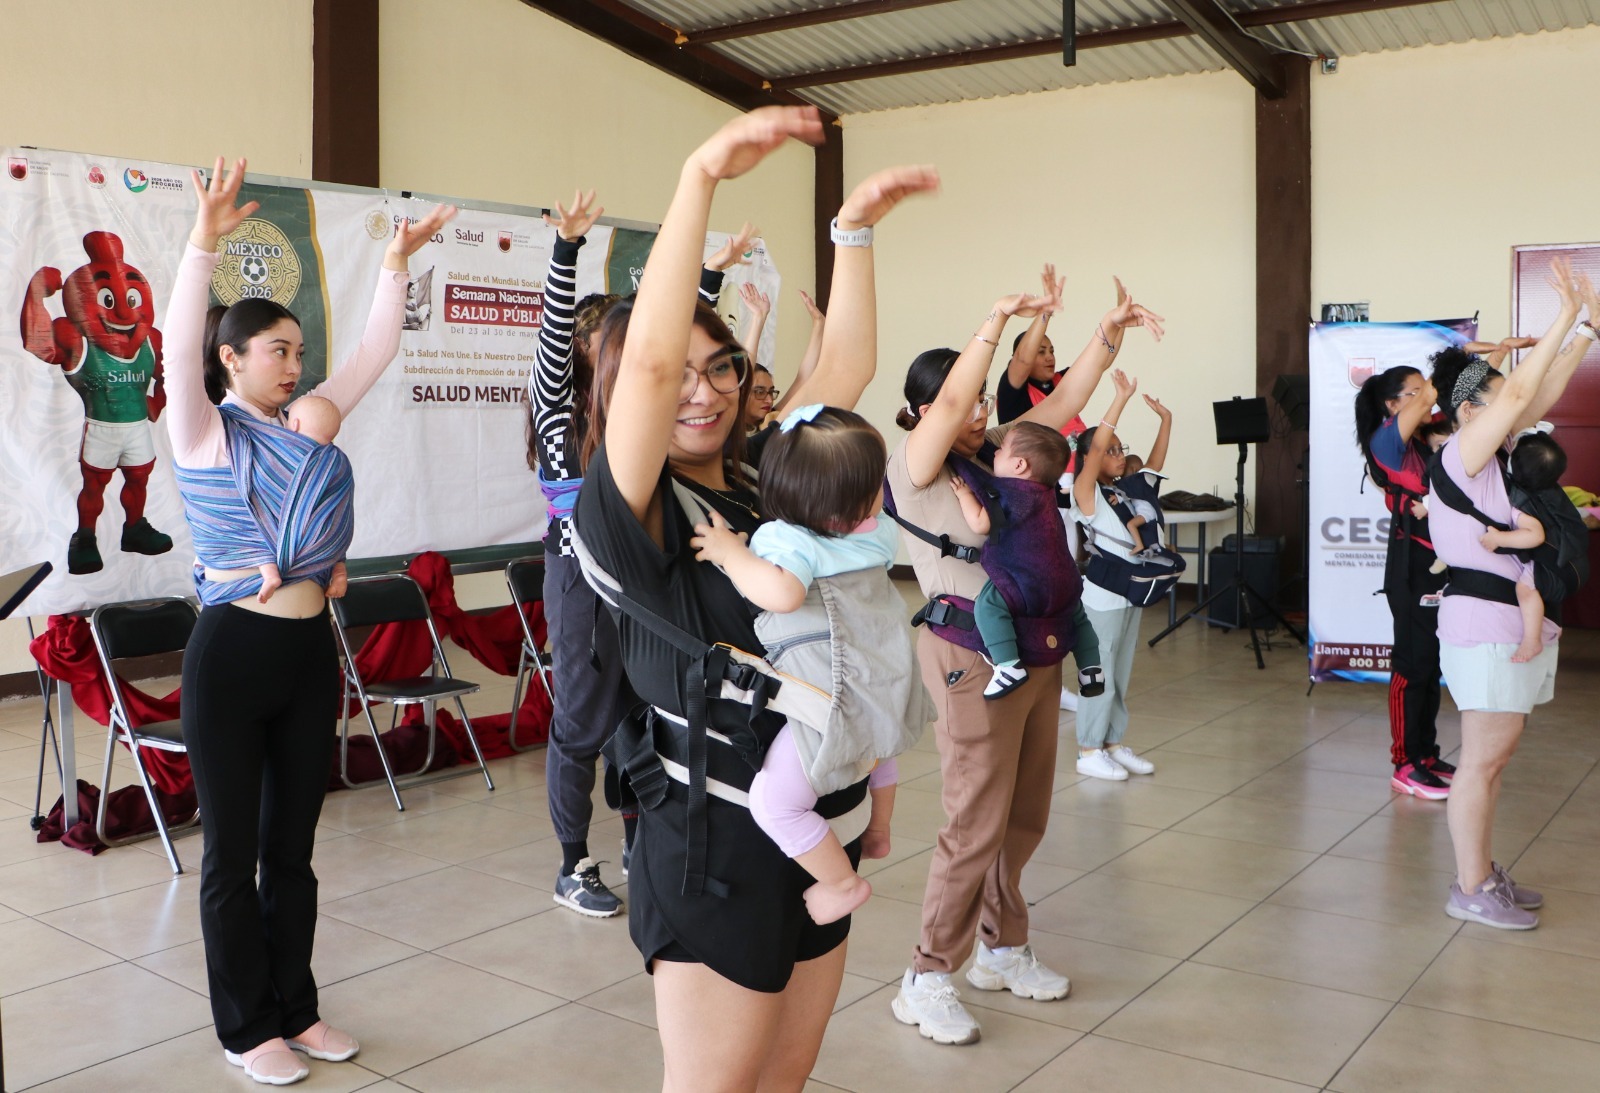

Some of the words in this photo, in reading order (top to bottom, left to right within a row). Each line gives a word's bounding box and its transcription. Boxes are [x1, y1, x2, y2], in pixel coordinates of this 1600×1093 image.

[455, 228, 484, 243] Salud
[227, 240, 282, 258] MÉXICO
[447, 271, 470, 281] Salud
[483, 275, 490, 283] el
[491, 276, 519, 286] Mundial
[521, 279, 542, 288] Social
[241, 285, 272, 299] 2026
[451, 286, 496, 302] Semana
[498, 291, 542, 306] Nacional
[450, 304, 499, 321] SALUD
[450, 326, 464, 334] Del
[468, 327, 478, 335] 23
[482, 327, 490, 336] al
[494, 328, 503, 336] 30
[506, 329, 516, 337] de
[417, 349, 438, 358] Salud
[440, 350, 455, 359] Nos
[473, 352, 482, 360] Es
[484, 352, 515, 361] Nuestro
[107, 369, 146, 383] Salud
[403, 365, 454, 375] Subdirección
[456, 366, 465, 375] de
[466, 366, 505, 376] Promoción
[506, 368, 516, 376] de
[518, 368, 525, 377] la
[412, 385, 471, 402] SALUD
[1314, 644, 1350, 656] Llama
[1352, 648, 1360, 656] a
[1362, 646, 1373, 657] la
[1349, 657, 1374, 668] 800
